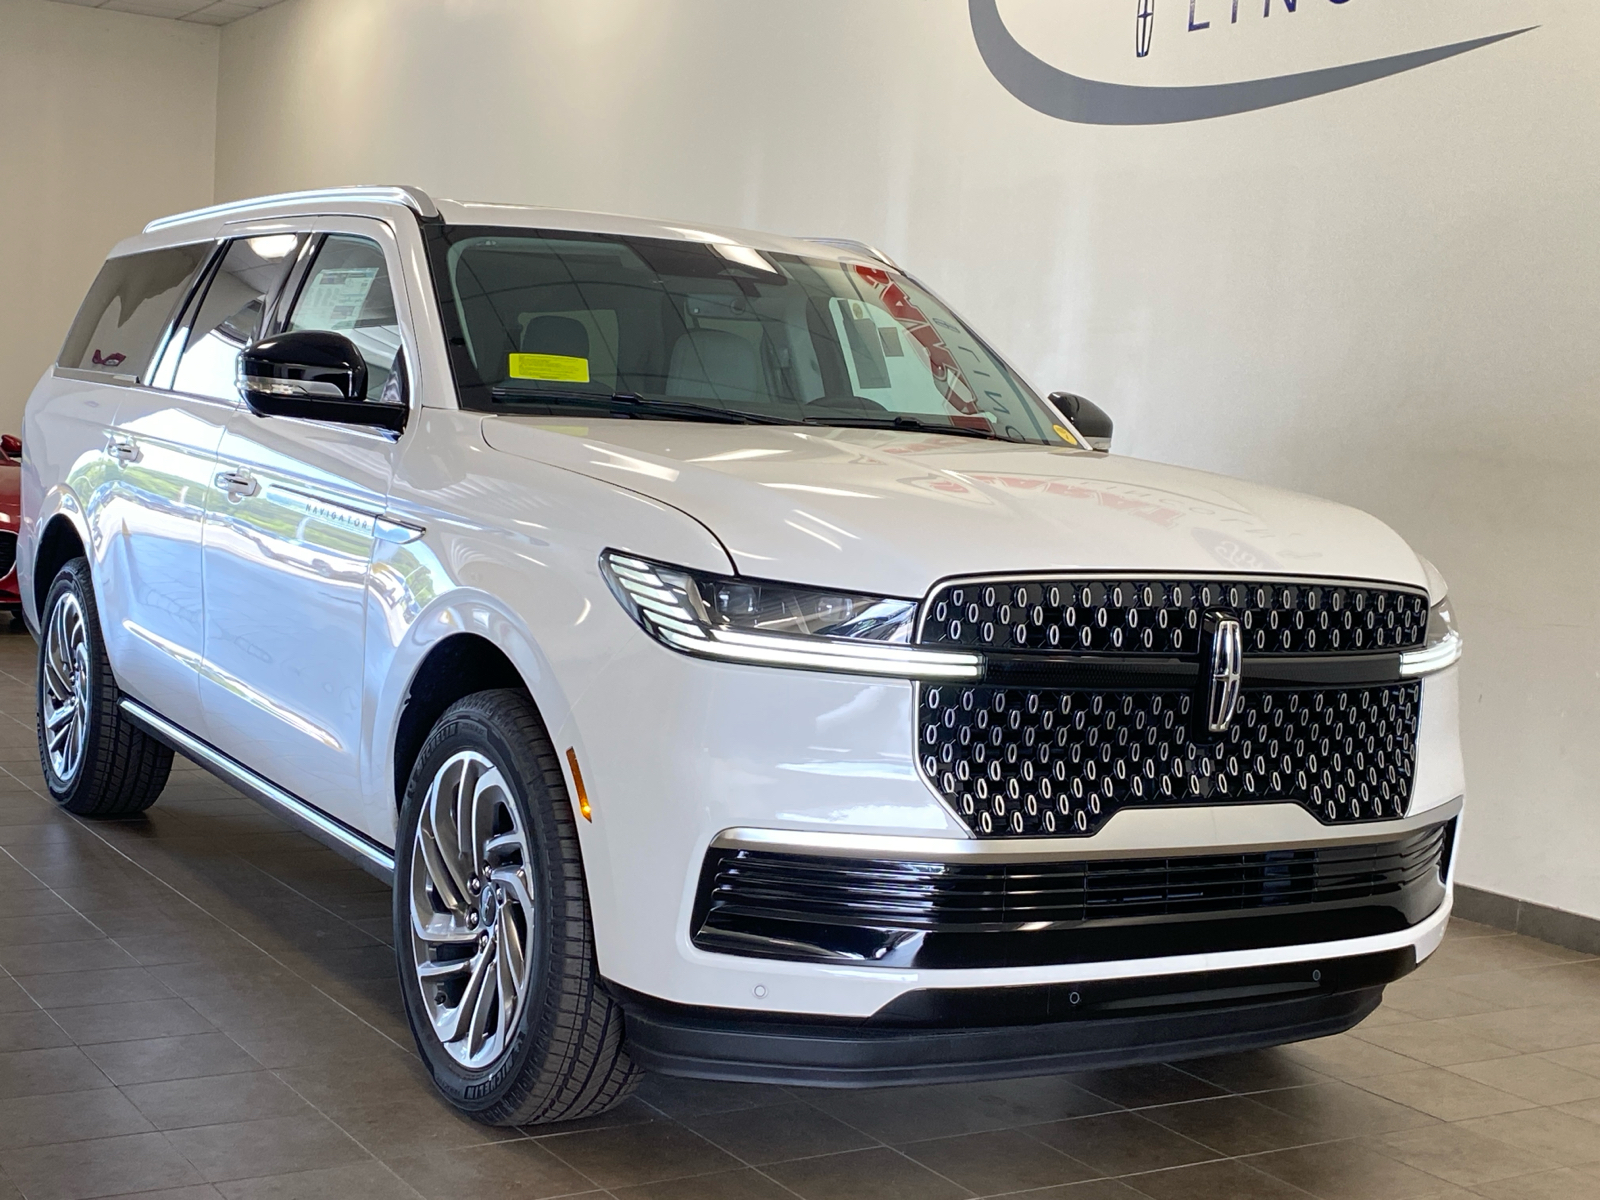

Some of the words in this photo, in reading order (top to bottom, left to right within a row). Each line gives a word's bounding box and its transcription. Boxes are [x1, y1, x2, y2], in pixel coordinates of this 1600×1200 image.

[1188, 0, 1350, 32] LI
[305, 503, 368, 529] NAVIGATOR
[416, 722, 458, 777] MICHELIN
[465, 1053, 515, 1100] MICHELIN
